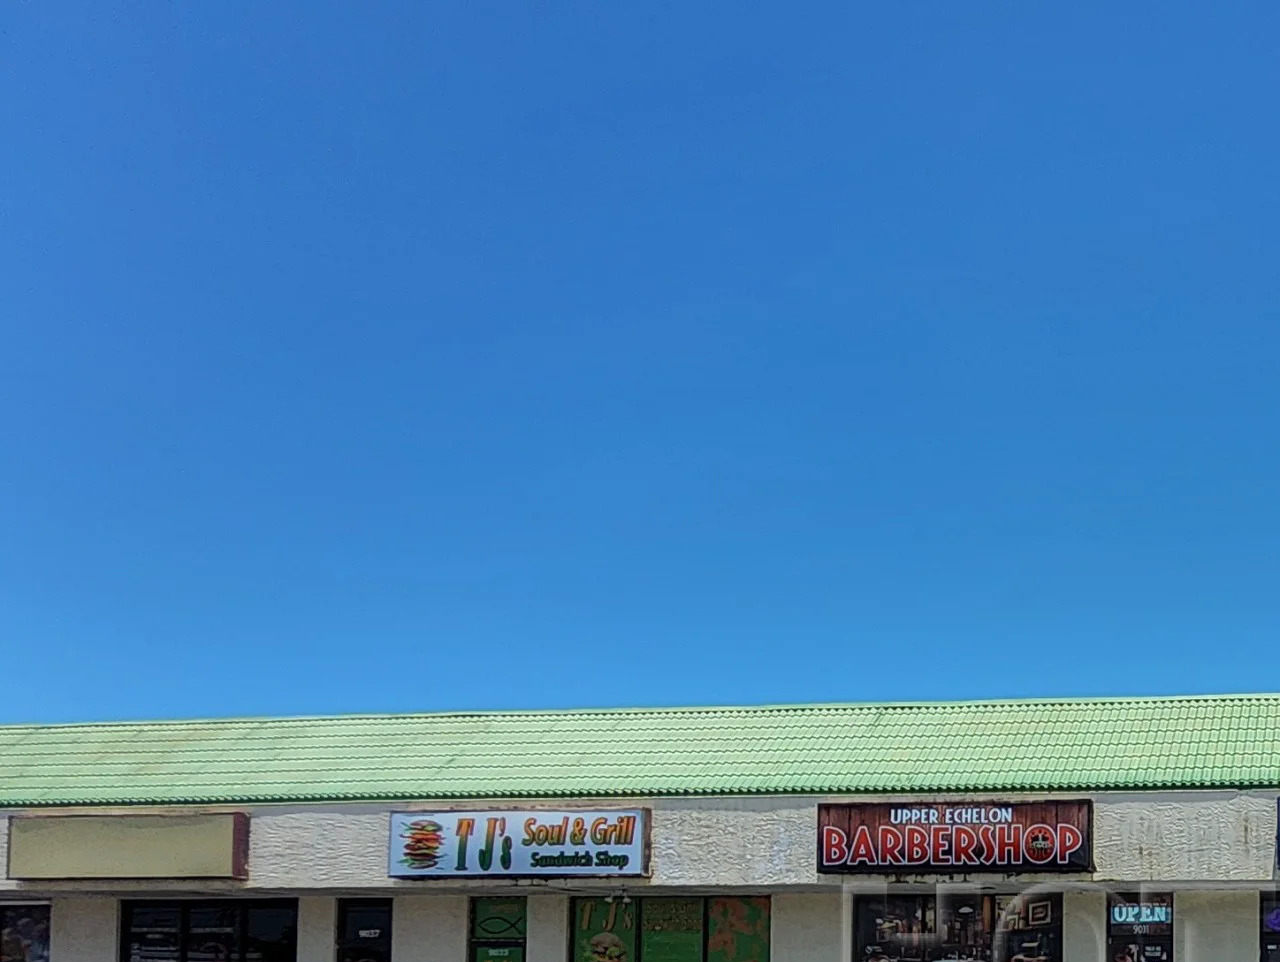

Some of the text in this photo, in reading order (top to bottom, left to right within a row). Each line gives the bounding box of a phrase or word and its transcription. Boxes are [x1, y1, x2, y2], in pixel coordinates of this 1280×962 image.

[890, 807, 1012, 824] UPPER ECHELON
[522, 816, 568, 846] Soul
[570, 818, 586, 846] &
[590, 815, 637, 846] Grill
[823, 824, 1083, 866] BARBERSHOP
[530, 851, 629, 870] Sandwich Shop
[1114, 906, 1166, 922] OPEN
